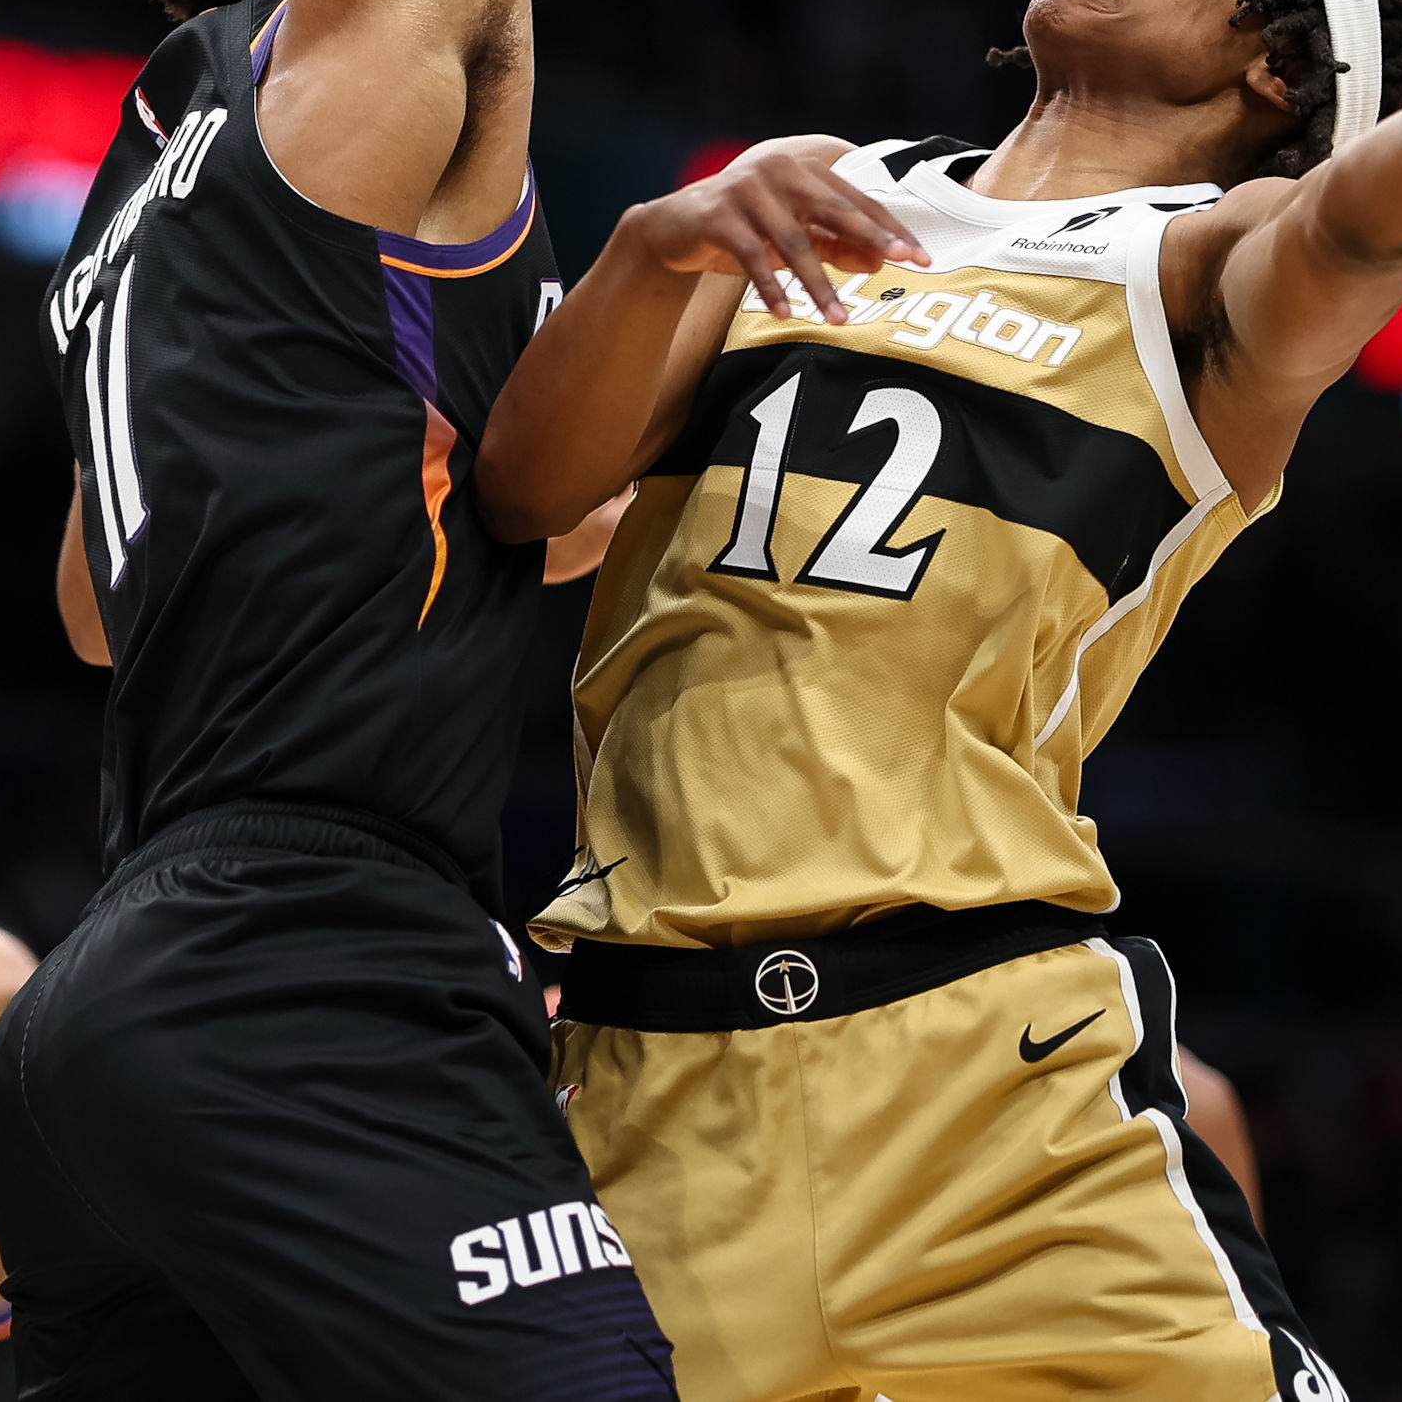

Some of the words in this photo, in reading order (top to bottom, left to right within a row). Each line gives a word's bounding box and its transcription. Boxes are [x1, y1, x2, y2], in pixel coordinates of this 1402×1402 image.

[1011, 237, 1110, 255] Robinhood
[86, 254, 150, 590] 11
[705, 370, 947, 601] 12
